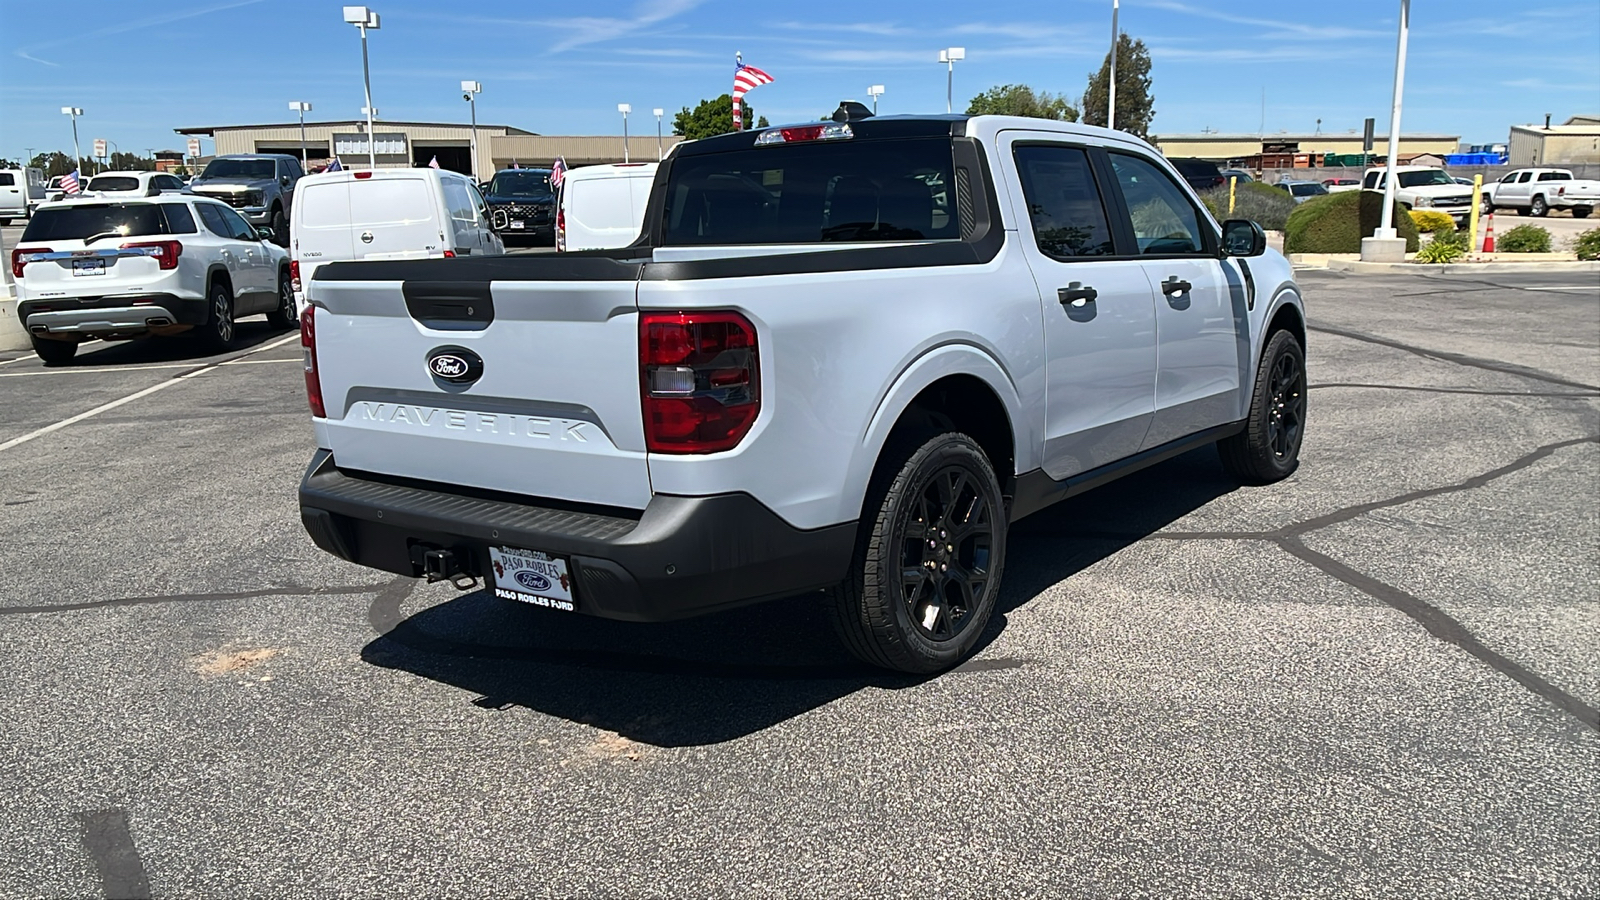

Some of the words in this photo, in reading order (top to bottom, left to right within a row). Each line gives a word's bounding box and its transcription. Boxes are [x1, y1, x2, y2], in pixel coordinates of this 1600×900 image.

[436, 357, 461, 375] Ford
[362, 402, 589, 443] MAVERICK
[501, 556, 523, 570] PASO
[525, 560, 559, 580] ROBLES
[522, 573, 545, 587] Ford
[495, 588, 517, 600] PASO
[517, 592, 550, 607] ROBLES
[550, 599, 574, 611] FORD
